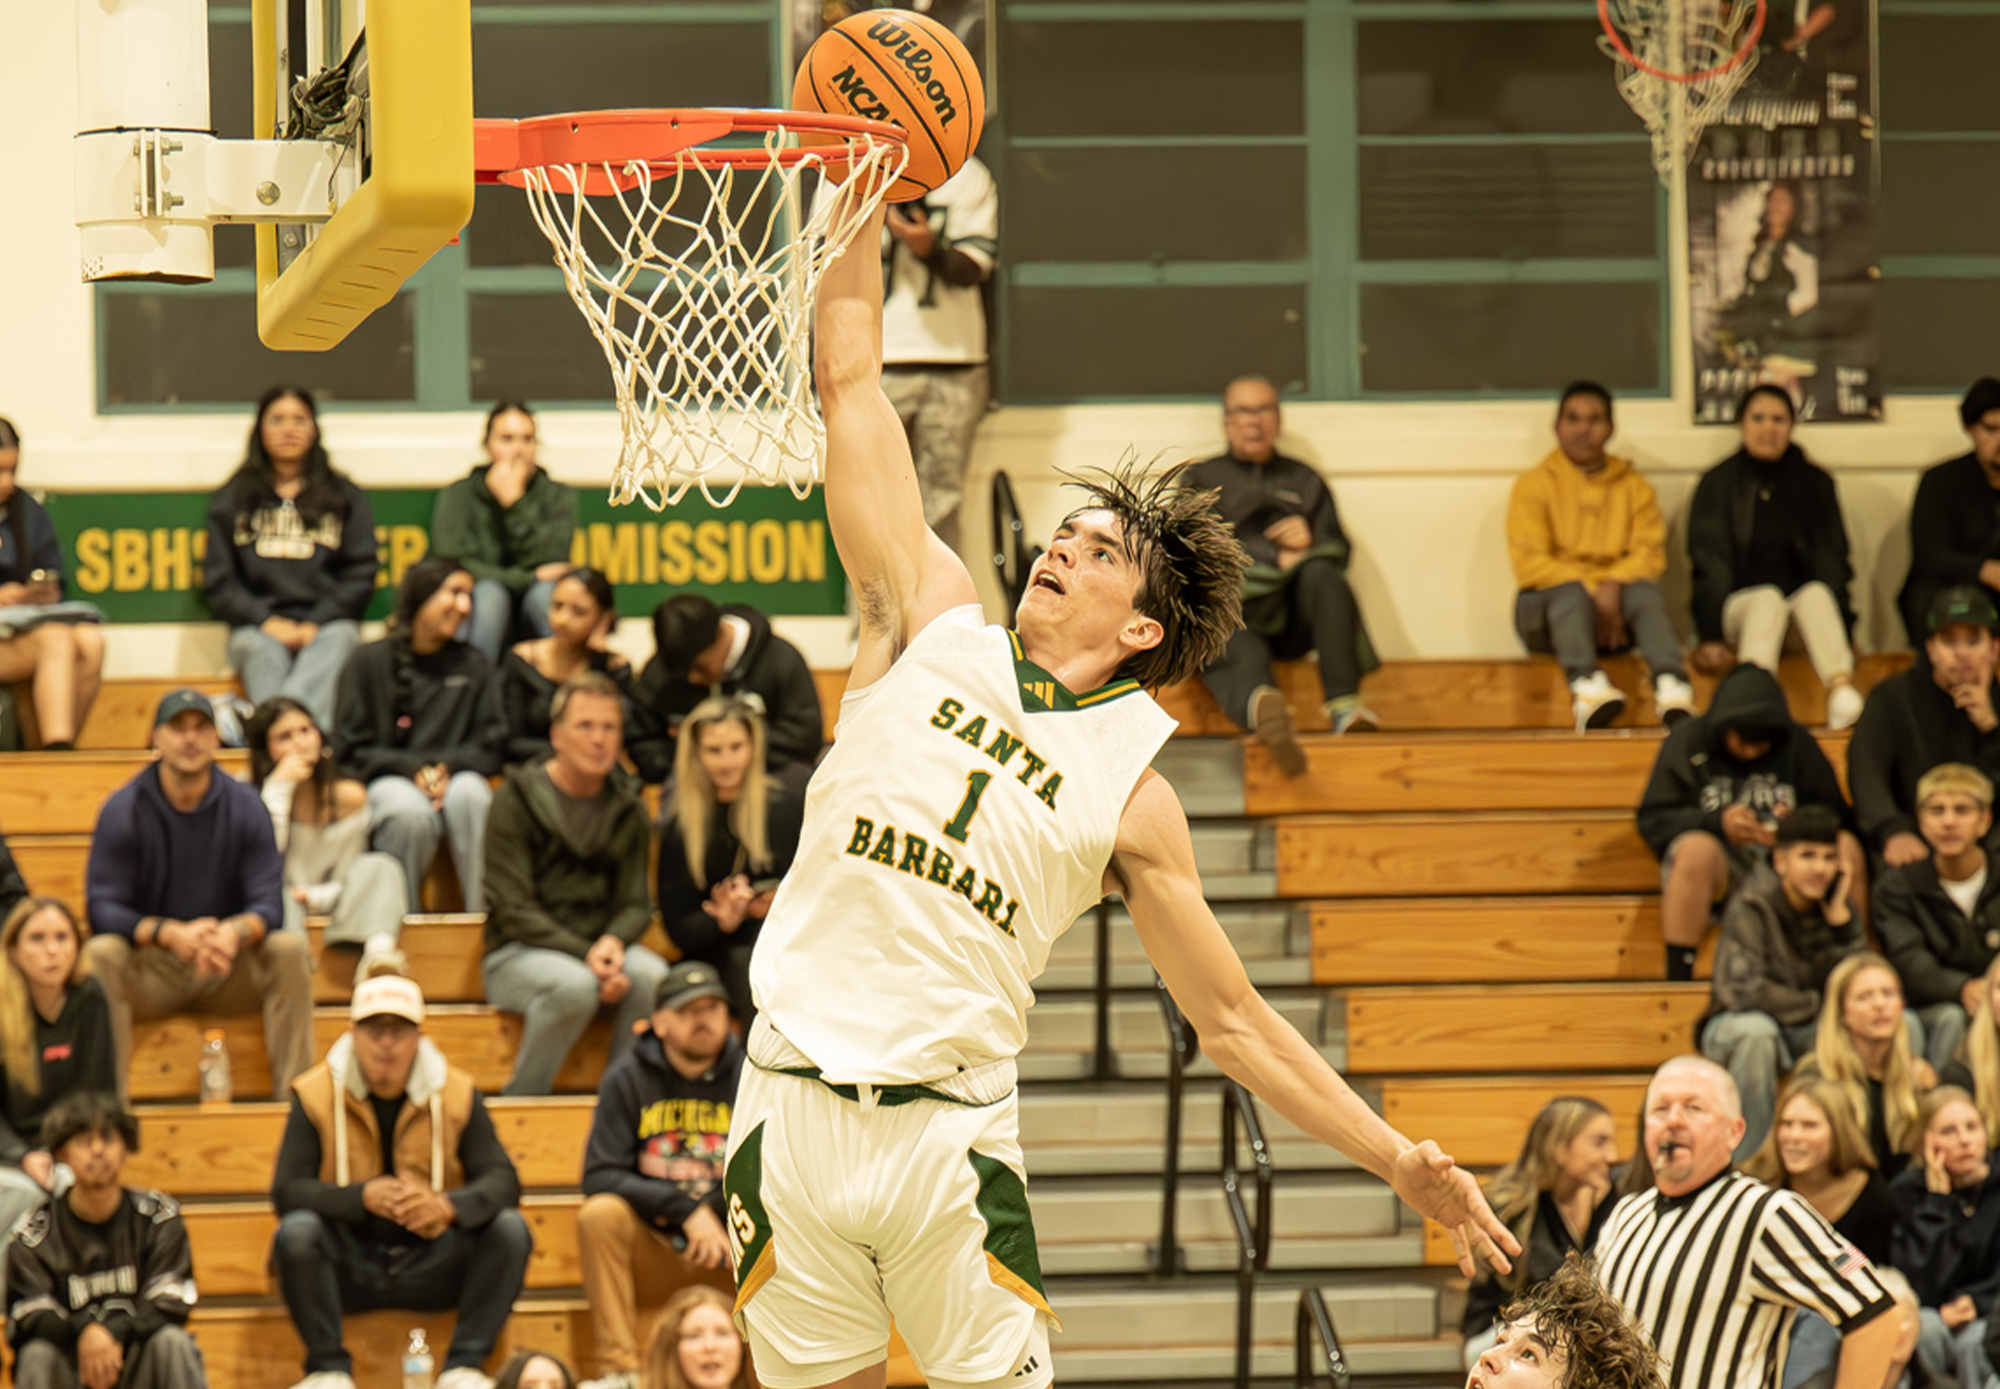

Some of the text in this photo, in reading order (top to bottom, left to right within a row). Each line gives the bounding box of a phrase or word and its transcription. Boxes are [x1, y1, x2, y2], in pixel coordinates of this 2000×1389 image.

[831, 64, 910, 134] NCA
[866, 18, 957, 128] Wilson
[570, 519, 826, 585] MISSION
[929, 696, 1064, 812] SANTA
[943, 768, 994, 846] 1
